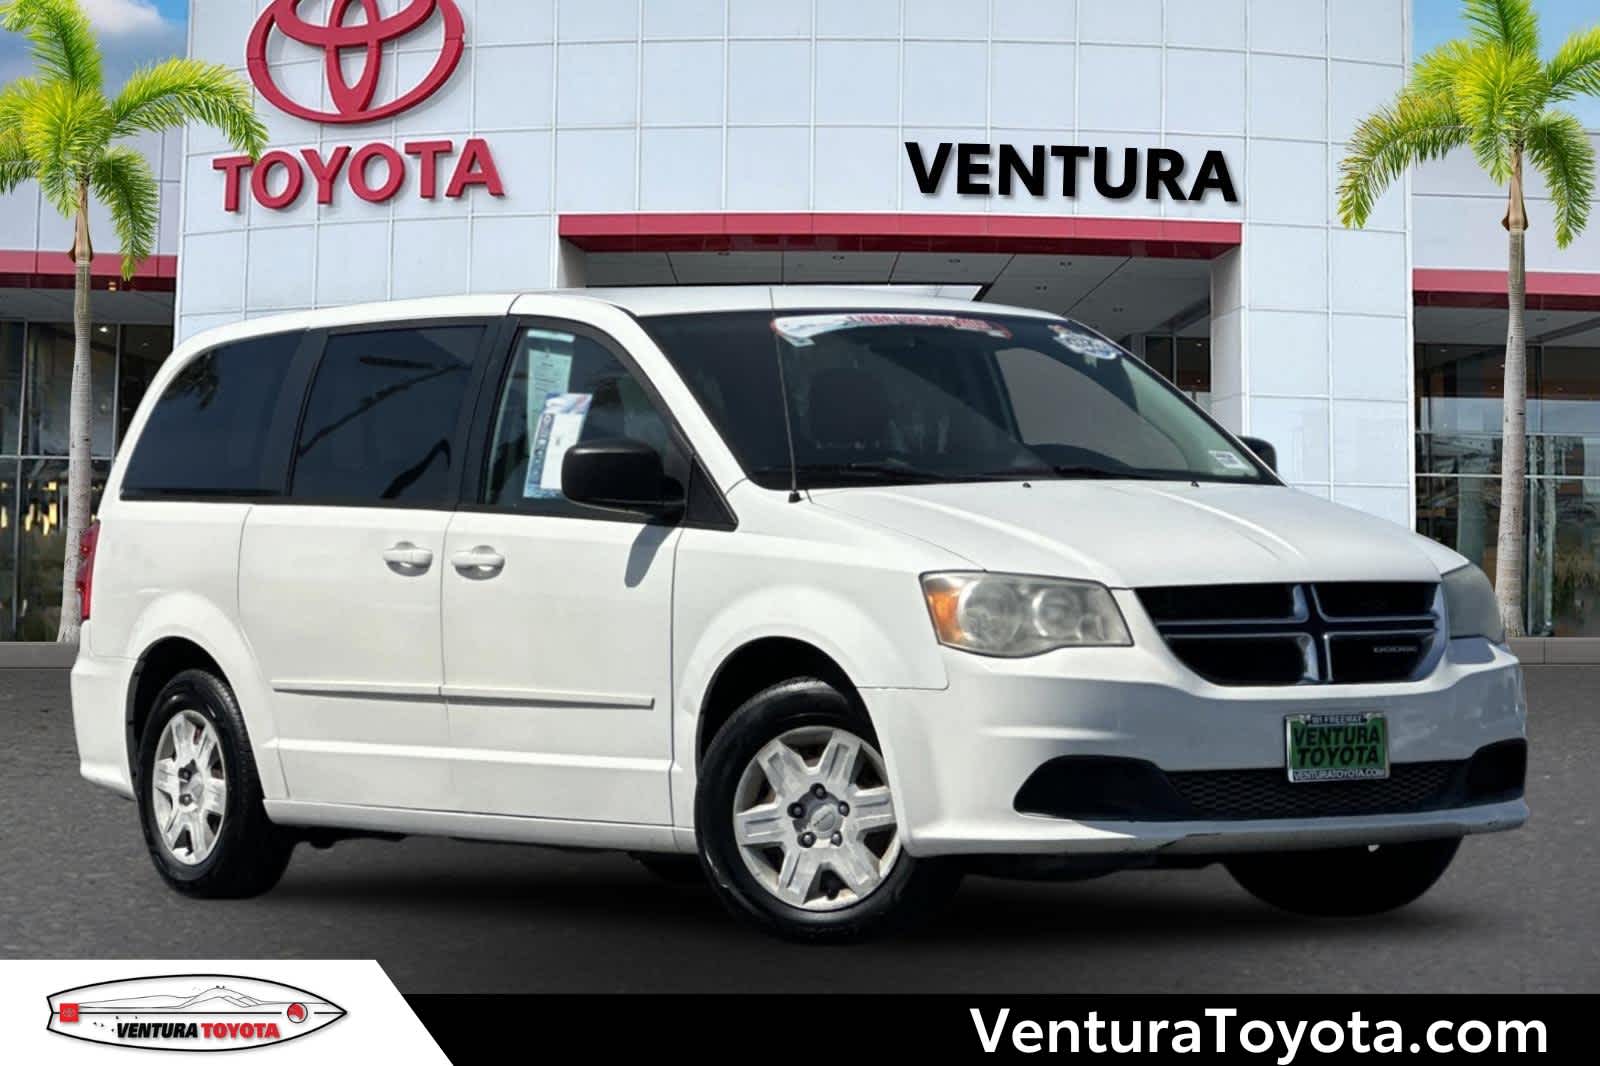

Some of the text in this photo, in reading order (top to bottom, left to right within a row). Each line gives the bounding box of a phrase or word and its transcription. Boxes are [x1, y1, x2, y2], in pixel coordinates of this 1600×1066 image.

[213, 138, 504, 212] TOYOTA
[904, 141, 1239, 202] VENTURA
[1293, 725, 1380, 746] VENTURA
[1297, 746, 1379, 767] TOYOTA
